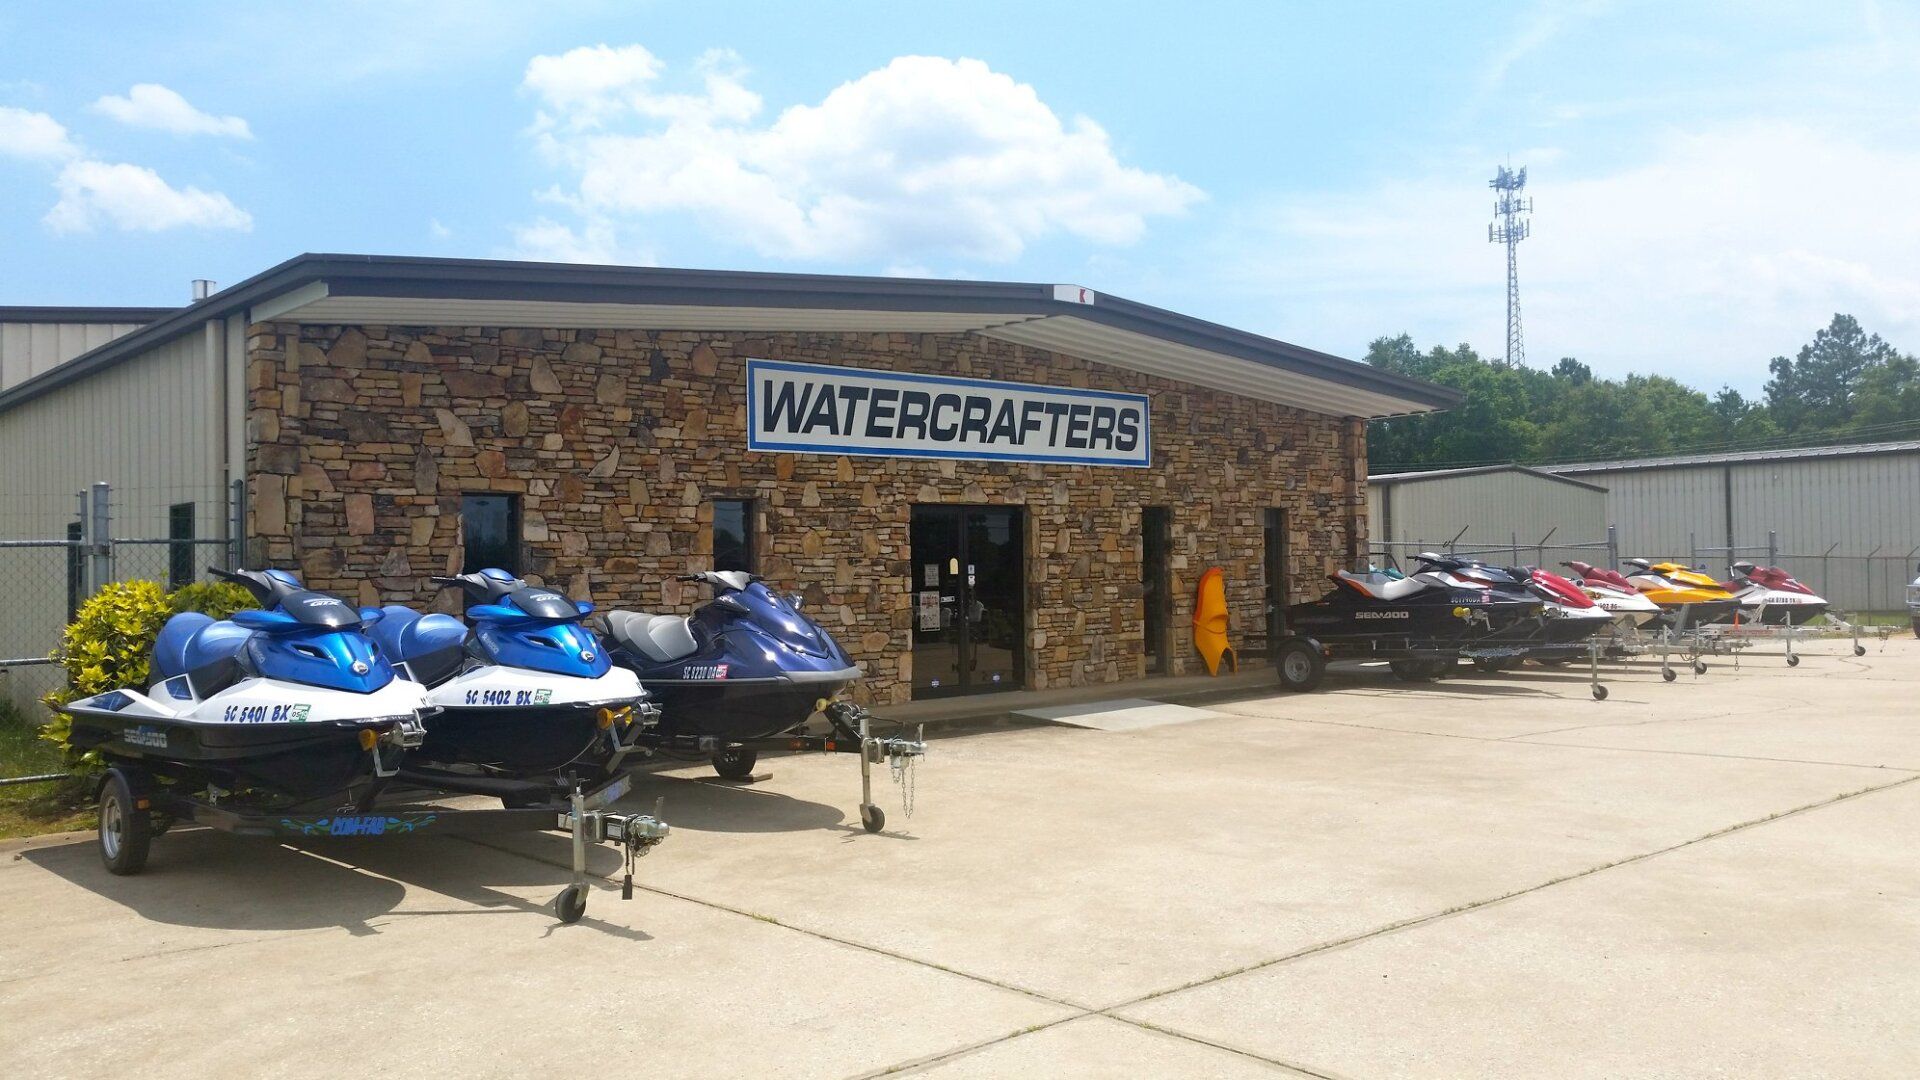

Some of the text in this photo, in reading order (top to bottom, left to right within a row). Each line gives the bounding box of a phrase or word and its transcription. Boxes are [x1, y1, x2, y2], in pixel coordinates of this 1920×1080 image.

[762, 379, 1140, 452] WATERCRAFTERS
[683, 666, 691, 679] SC
[465, 689, 532, 706] SC 5402 BX
[224, 704, 292, 723] SC 5401 BX
